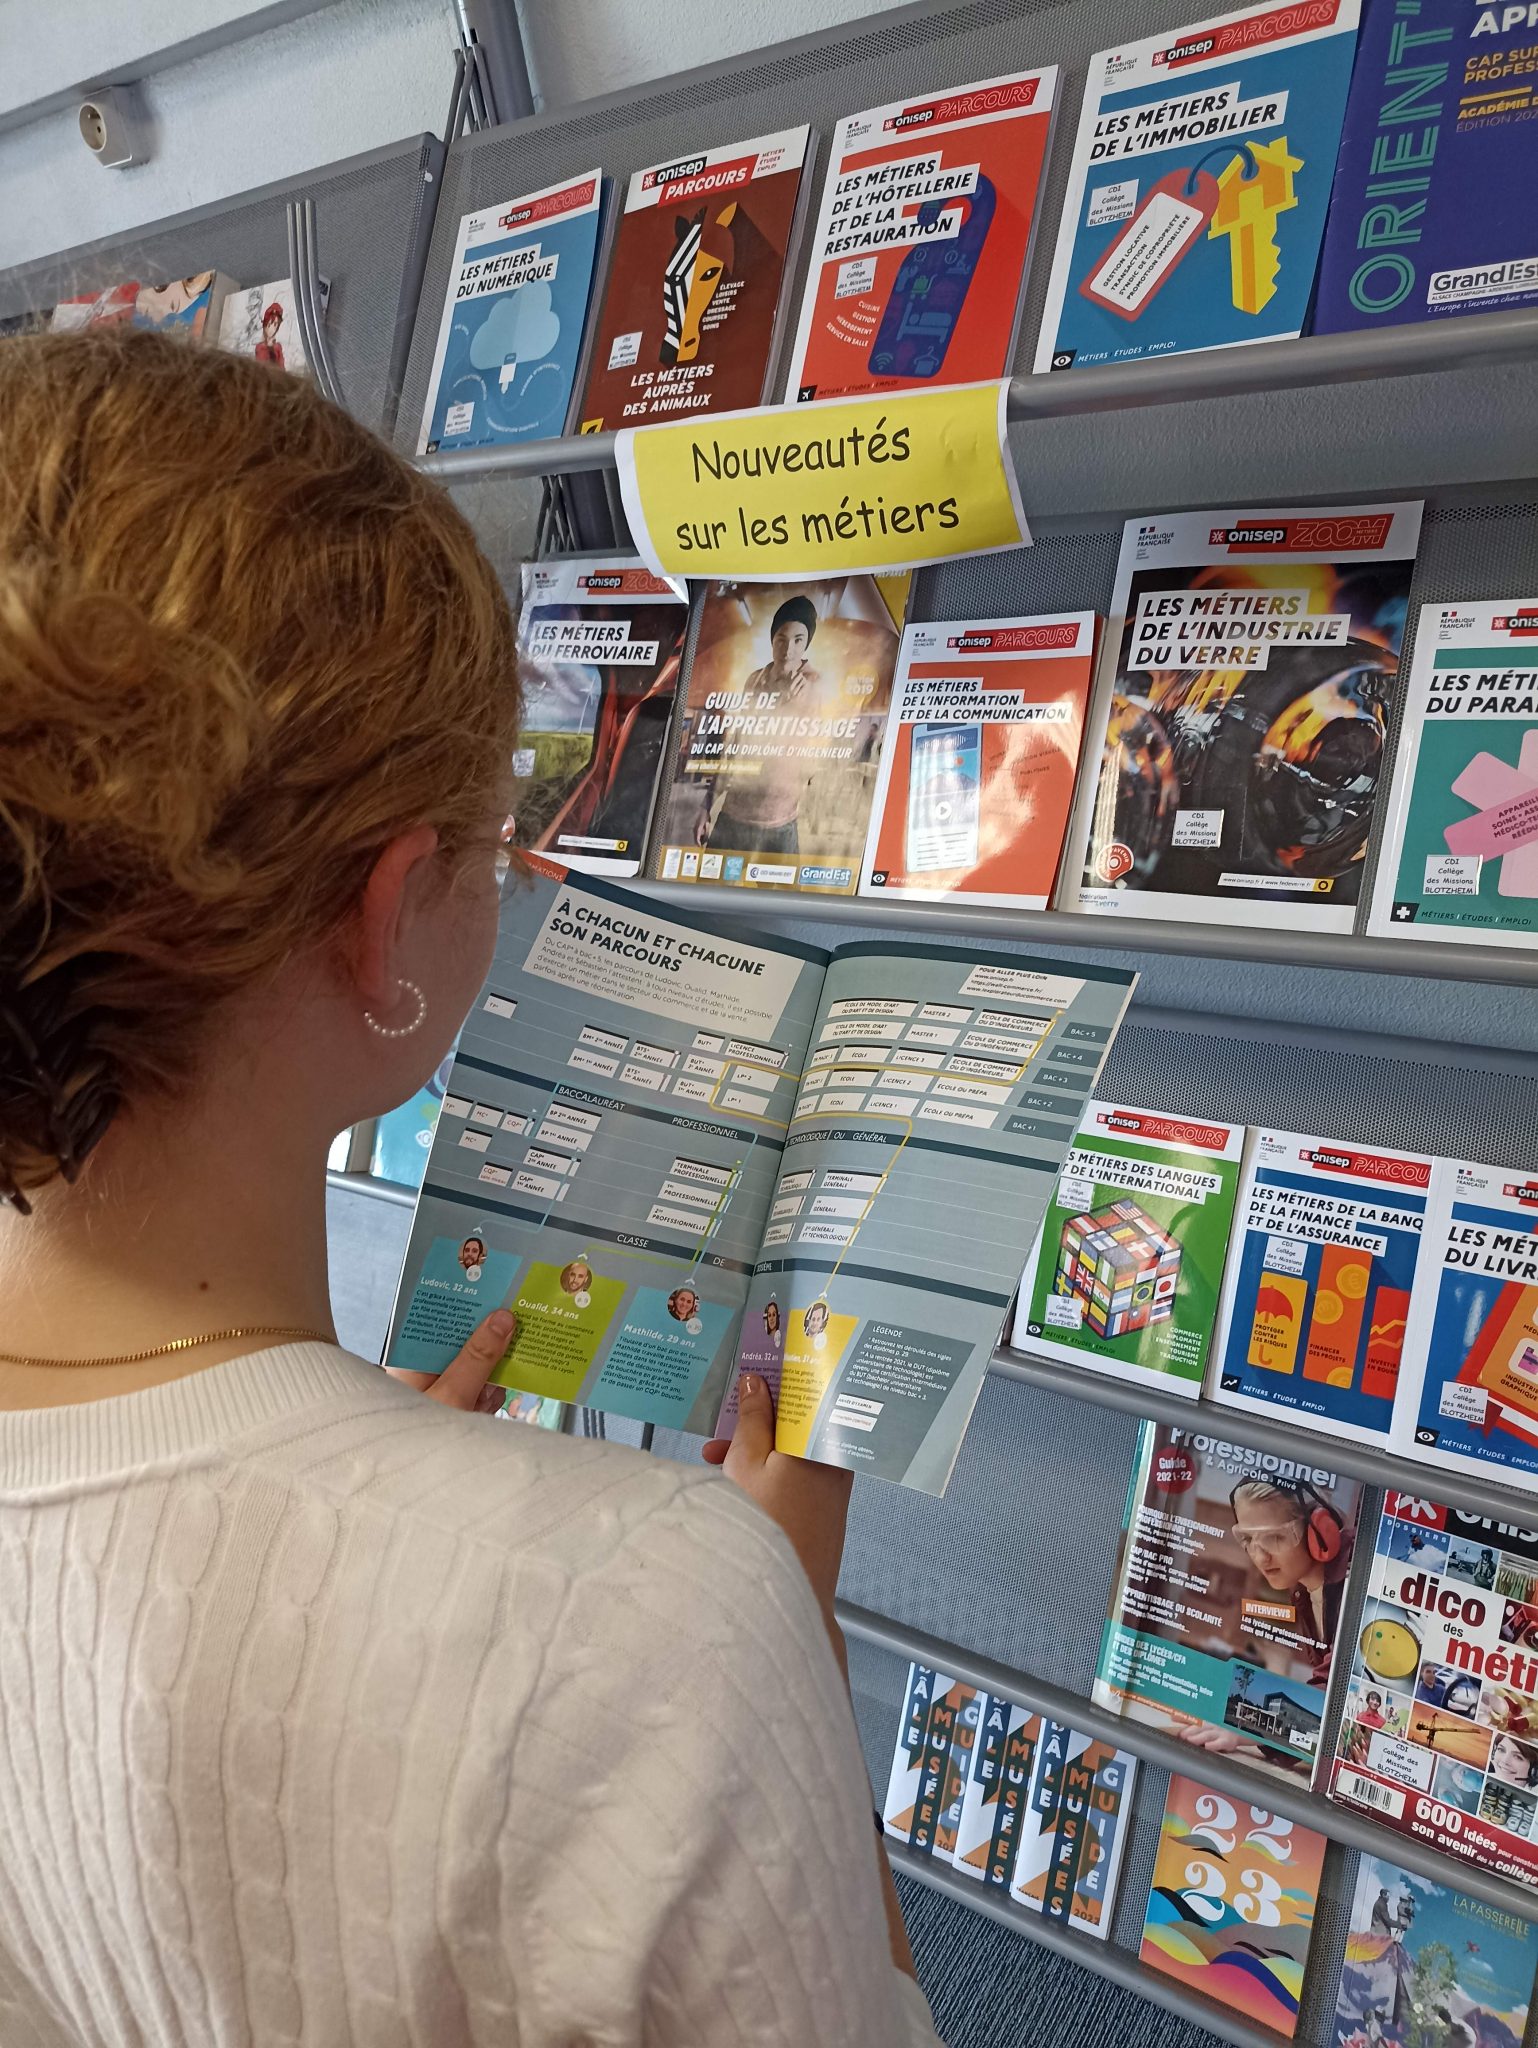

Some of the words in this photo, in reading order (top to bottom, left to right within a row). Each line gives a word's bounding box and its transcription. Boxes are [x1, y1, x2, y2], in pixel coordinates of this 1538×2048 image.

[1167, 39, 1213, 61] onisep
[1218, 1, 1336, 50] PARCOURS
[896, 109, 933, 127] onisep
[936, 83, 1034, 119] PARCOURS
[1094, 116, 1128, 137] LES
[1135, 92, 1230, 130] MÉTIERS
[1090, 144, 1117, 160] DE
[1123, 103, 1278, 153] L'IMMOBILIER
[657, 161, 705, 188] onisep
[664, 167, 748, 201] PARCOURS
[836, 177, 860, 196] LES
[865, 159, 937, 189] MÉTIERS
[506, 210, 531, 226] onisep
[533, 182, 593, 219] PARCOURS
[832, 199, 852, 215] DE
[856, 172, 973, 210] L'HÔTELLERIE
[828, 220, 846, 236] ET
[850, 212, 872, 231] DE
[876, 207, 896, 225] LA
[1089, 211, 1133, 226] BLOTZHEIM
[824, 217, 954, 256] RESTAURATION
[460, 263, 481, 282] LES
[485, 249, 537, 276] MÉTIERS
[1103, 255, 1125, 287] GESTION
[1123, 224, 1149, 256] LOCATIVE
[1110, 244, 1148, 292] TRANSACTION
[1119, 267, 1140, 296] SYNDIC
[1138, 256, 1148, 269] DE
[1144, 214, 1180, 258] COPROPRIÉTÉ
[1127, 262, 1155, 300] PROMOTION
[1153, 216, 1190, 264] IMMOBILIÈRE
[456, 282, 477, 299] DU
[482, 261, 554, 295] NUMÉRIQUE
[836, 315, 873, 335] HÉBERGEMENT
[1078, 352, 1108, 363] MÉTIERS
[1114, 347, 1142, 357] ÉTUDES
[1149, 341, 1176, 351] EMPLOI
[630, 378, 653, 393] LES
[657, 363, 715, 388] MÉTIERS
[642, 381, 695, 400] AUPRÈS
[623, 403, 647, 417] DES
[651, 394, 712, 411] ANIMAUX
[691, 416, 910, 484] Nouveautés
[677, 518, 726, 551] sur
[738, 506, 788, 547] les
[801, 495, 959, 544] métiers
[1138, 531, 1175, 542] RÉPUBLIQUE
[1228, 527, 1283, 544] onisep
[1290, 518, 1386, 548] ZOOM
[1142, 597, 1182, 618] LES
[1189, 591, 1301, 616] MÉTIERS
[534, 627, 558, 641] LES
[561, 622, 624, 642] MÉTIERS
[1139, 622, 1170, 641] DE
[1178, 620, 1342, 641] L'INDUSTRIE
[1440, 617, 1476, 625] RÉPUBLIQUE
[958, 636, 991, 648] onisep
[994, 628, 1075, 648] PARCOURS
[1135, 646, 1170, 665] DU
[1180, 645, 1261, 665] VERRE
[905, 681, 925, 694] LES
[927, 679, 978, 693] MÉTIERS
[1429, 674, 1471, 692] LES
[705, 691, 751, 711] GUIDE
[756, 691, 781, 711] DE
[900, 709, 914, 720] ET
[917, 709, 931, 720] DE
[934, 708, 948, 719] LA
[953, 708, 1068, 720] COMMUNICATION
[902, 696, 917, 707] DE
[920, 695, 1020, 707] L'INFORMATION
[1426, 696, 1461, 714] DU
[697, 715, 862, 740] L'APPRENTISSAGE
[1174, 838, 1217, 846] BLOTZHEIM
[549, 917, 588, 941] SON
[590, 930, 683, 972] PARCOURS
[557, 898, 570, 916] À
[574, 907, 651, 942] CHACUN
[653, 934, 676, 951] ET
[678, 943, 765, 977] CHACUNE
[1071, 1028, 1086, 1036] BAC
[727, 1048, 781, 1067] PROFESSIONNELLE
[559, 1086, 626, 1111] BACCALAURÉAT
[672, 1116, 740, 1139] PROFESSIONNEL
[833, 1131, 845, 1139] OU
[853, 1131, 887, 1144] GÉNÉRAL
[1012, 1121, 1028, 1129] BAC
[1107, 1115, 1140, 1130] onisep
[1142, 1118, 1224, 1146] PARCOURS
[1078, 1151, 1129, 1173] MÉTIERS
[1131, 1162, 1153, 1178] DES
[1157, 1168, 1216, 1189] LANGUES
[1311, 1152, 1350, 1168] onisep
[673, 1168, 728, 1186] PROFESSIONNELLE
[1070, 1164, 1086, 1177] DE
[1089, 1168, 1200, 1200] L'INTERNATIONAL
[664, 1189, 718, 1208] PROFESSIONNELLE
[1251, 1186, 1275, 1200] LES
[1277, 1190, 1335, 1212] MÉTIERS
[1339, 1202, 1357, 1216] DE
[1359, 1207, 1376, 1220] LA
[1381, 1212, 1424, 1232] BANQ
[652, 1213, 706, 1232] PROFESSIONNELLE
[1249, 1200, 1268, 1214] DE
[1270, 1204, 1287, 1217] LA
[1290, 1208, 1353, 1230] FINANCE
[1247, 1214, 1263, 1226] ET
[1266, 1218, 1283, 1231] DE
[1286, 1222, 1382, 1251] L'ASSURANCE
[1444, 1247, 1479, 1266] DU
[873, 1325, 904, 1338] LÉGENDE
[1154, 1336, 1200, 1353] ENSEIGNEMENT
[1243, 1384, 1269, 1397] MÉTIERS
[1273, 1392, 1298, 1405] ÉTUDES
[1301, 1400, 1326, 1412] EMPLOI
[1459, 1385, 1473, 1394] CDI
[1500, 1378, 1538, 1401] GRAPHIQUE
[1386, 1518, 1447, 1544] DOSSIERS
[1246, 1602, 1291, 1619] INTERVIEWS
[1382, 1584, 1396, 1599] Le
[1400, 1572, 1487, 1628] dico
[1443, 1621, 1464, 1638] des
[1396, 1743, 1409, 1753] CDI
[915, 1707, 954, 1848] MUSÉES
[948, 1705, 980, 1822] GUIDE
[1377, 1763, 1418, 1785] BLOTZHEIM
[991, 1740, 1030, 1885] MUSÉES
[1050, 1766, 1088, 1917] MUSÉES
[1084, 1766, 1120, 1892] GUIDE
[1191, 1794, 1294, 1861] 22
[1415, 1797, 1463, 1835] 600
[1463, 1827, 1498, 1852] idées
[1497, 1849, 1512, 1862] pour
[1180, 1860, 1292, 1928] 23
[1073, 1907, 1100, 1926] 2022
[1454, 1895, 1468, 1908] LA
[1470, 1902, 1531, 1937] PASSERELLE
